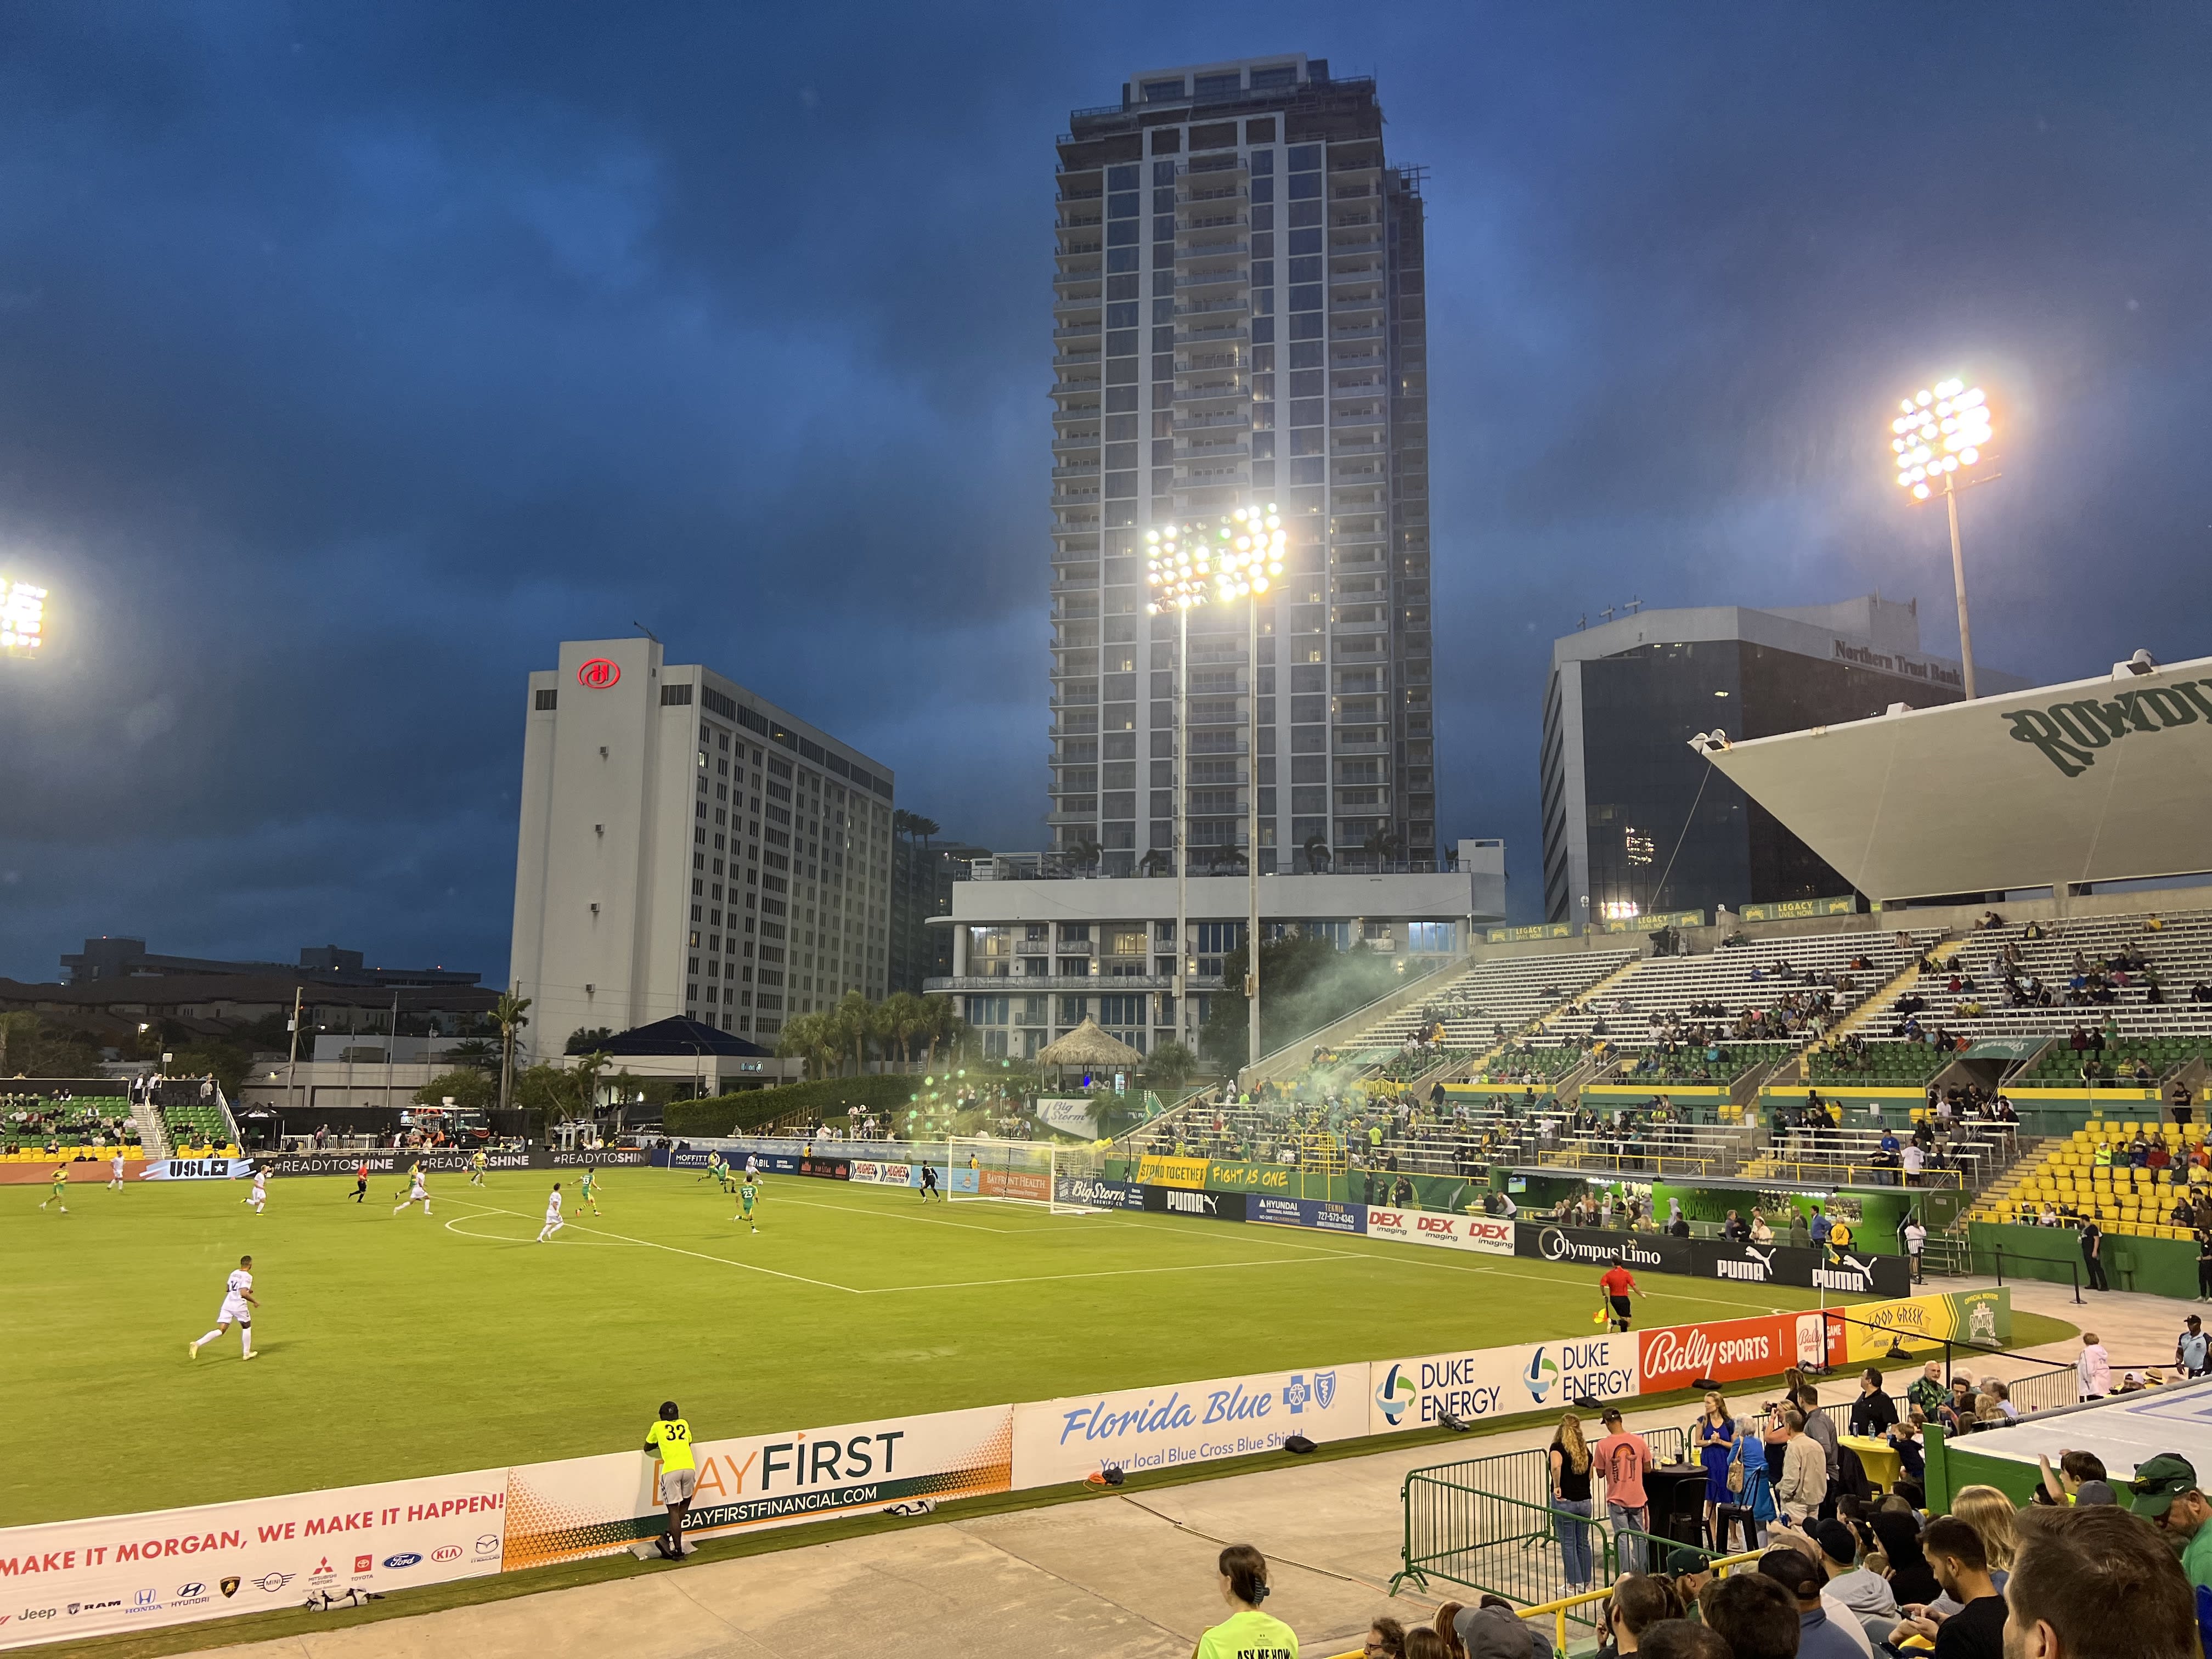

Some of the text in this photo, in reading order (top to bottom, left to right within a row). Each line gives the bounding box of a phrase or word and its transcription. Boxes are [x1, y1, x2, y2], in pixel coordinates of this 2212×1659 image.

[1835, 640, 1962, 685] Northern Trust Bank
[2001, 678, 2212, 777] ROWDI
[1053, 1101, 1074, 1113] Big
[1051, 1111, 1085, 1121] Storm
[421, 1155, 529, 1169] #READYSHINE
[856, 1163, 875, 1175] HUGHES
[887, 1165, 907, 1177] HUGHES
[1212, 1166, 1289, 1187] FIGHT AS ONE
[987, 1173, 1045, 1189] BAYFRONT HEALTH
[743, 1190, 753, 1198] 23
[1167, 1190, 1204, 1213] PUMA
[1266, 1200, 1297, 1211] HYUNDAI
[1318, 1211, 1355, 1224] 727-573-4343
[1369, 1211, 1404, 1228] DEX
[1417, 1216, 1454, 1234] DEX
[1376, 1225, 1407, 1235] imaging
[1425, 1231, 1458, 1242] imaging
[1469, 1222, 1510, 1240] DEX
[1478, 1237, 1514, 1249] imaging
[1553, 1235, 1661, 1265] Olympus Limo
[1717, 1259, 1764, 1282] PUMA
[1812, 1268, 1865, 1292] PUMA
[1964, 1293, 1999, 1305] OFFICIAL MOVERS
[1897, 1306, 1923, 1326] GREEK
[1798, 1328, 1822, 1347] Bally
[1827, 1324, 1842, 1336] GAME
[1827, 1338, 1835, 1350] ON
[1563, 1342, 1609, 1371] DUKE
[1644, 1328, 1769, 1380] Bally SPORTS
[1421, 1358, 1474, 1390] DUKE
[1563, 1368, 1633, 1402] ENERGY
[1421, 1386, 1501, 1423] ENERGY
[1059, 1383, 1273, 1446] Florida Blue
[665, 1424, 686, 1441] 32
[1134, 1449, 1164, 1468] local
[1169, 1446, 1196, 1463] Blue
[1200, 1442, 1234, 1457] Cross
[1237, 1436, 1264, 1452] Blue
[681, 1486, 877, 1529] BAYFIRSTFINANCIAL.COM
[0, 1493, 504, 1576] MAKE IT MORGAN, WE MAKE IT HAPPEN!
[391, 1555, 415, 1567] Ford
[437, 1548, 458, 1560] KIA
[266, 1578, 281, 1587] MINI
[308, 1573, 337, 1582] MITSUBISHI
[84, 1600, 121, 1610] RAM
[125, 1604, 163, 1614] HONDA
[171, 1596, 210, 1608] HYUNDAI
[18, 1607, 57, 1621] Jeep
